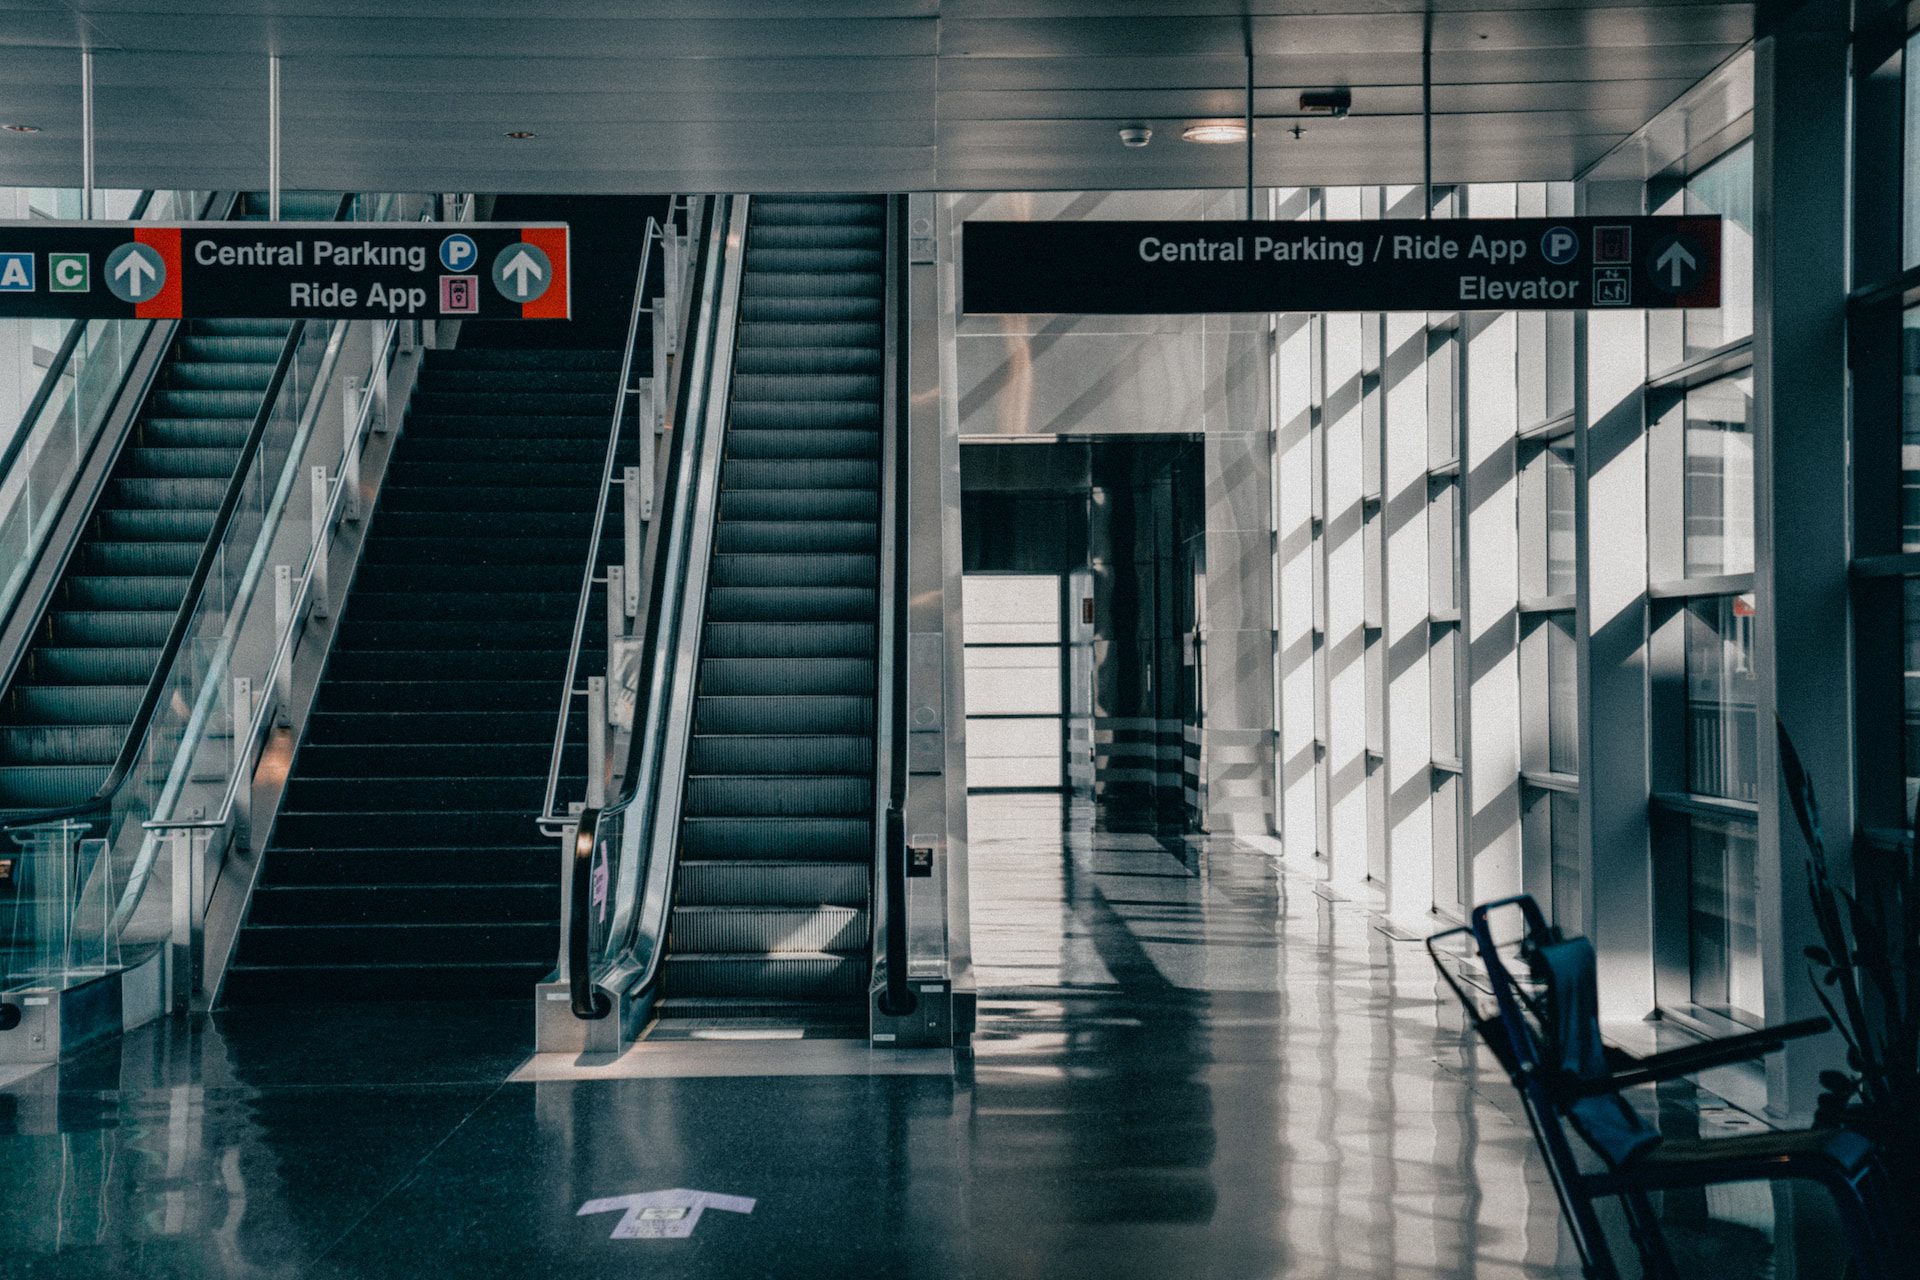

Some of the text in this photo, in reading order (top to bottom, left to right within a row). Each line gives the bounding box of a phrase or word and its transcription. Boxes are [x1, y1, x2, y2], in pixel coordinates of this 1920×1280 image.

[195, 240, 303, 265] Central
[449, 241, 471, 265] P
[1139, 235, 1527, 266] Central Parking / Ride App
[1551, 234, 1573, 257] P
[1, 258, 83, 287] A C
[290, 282, 426, 313] Ride App
[1459, 276, 1579, 300] Elevator
